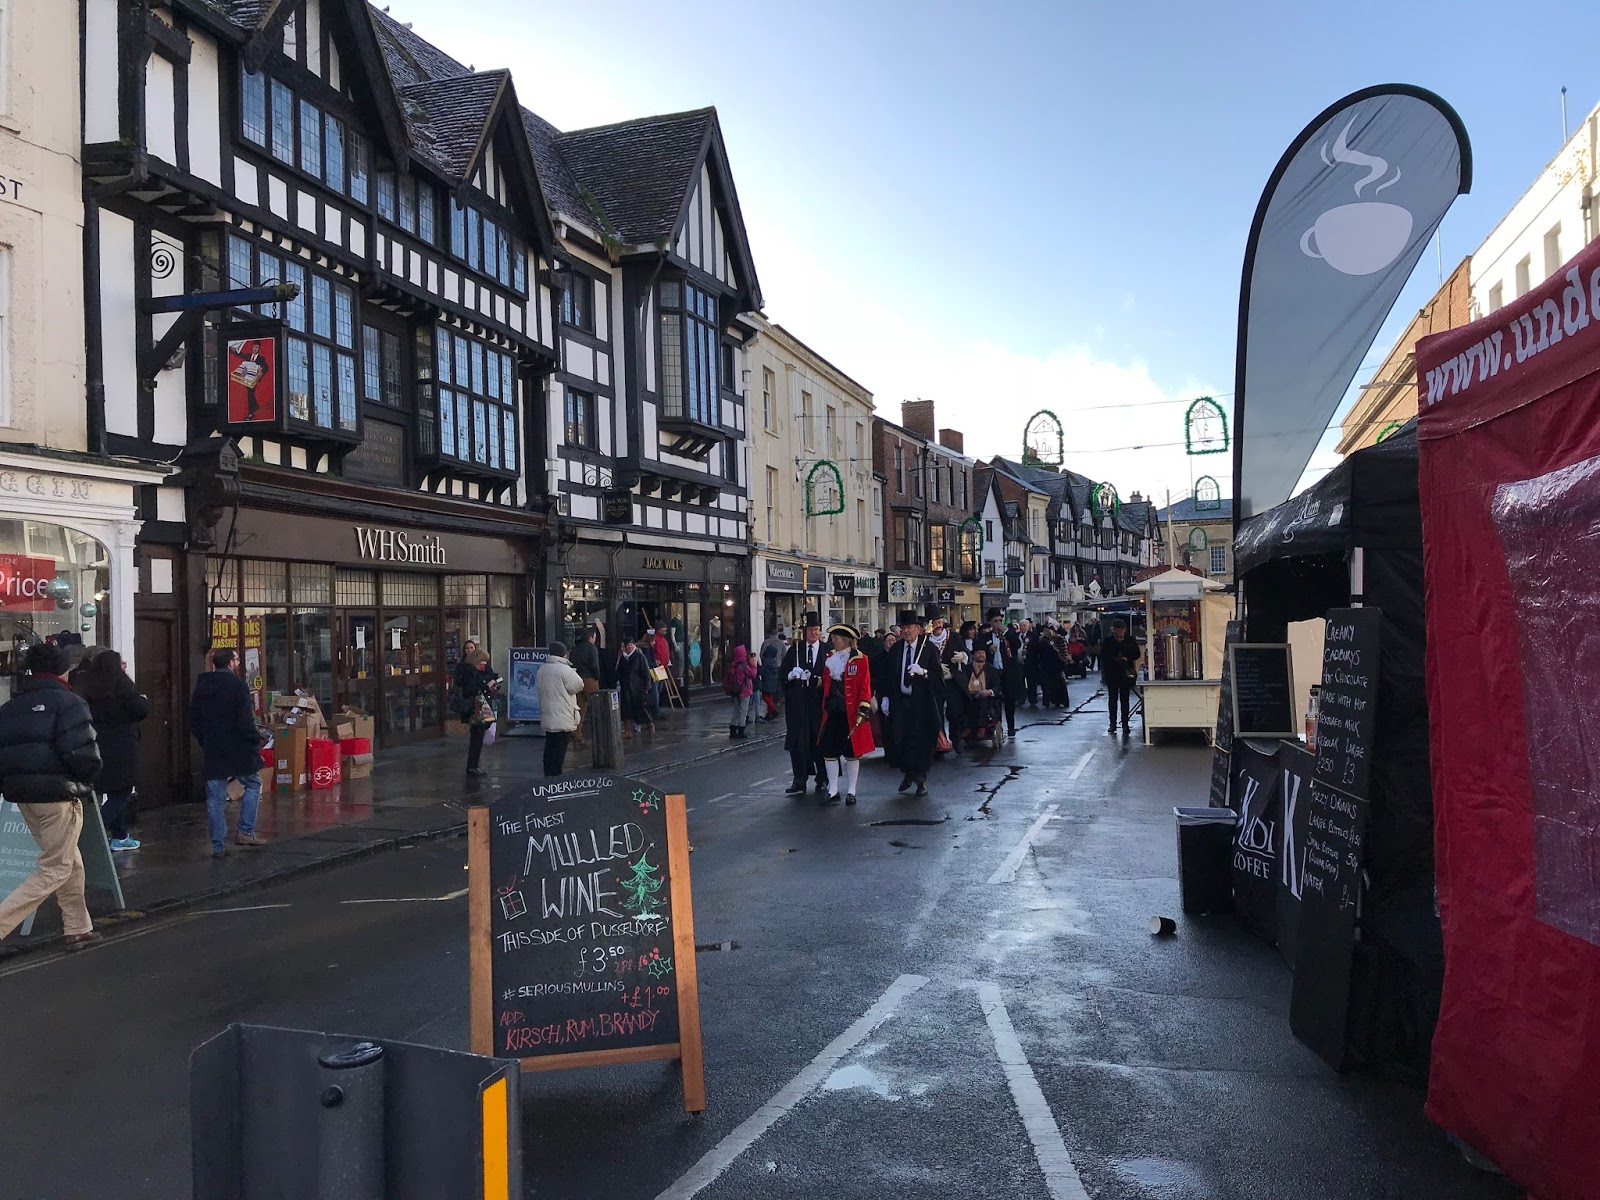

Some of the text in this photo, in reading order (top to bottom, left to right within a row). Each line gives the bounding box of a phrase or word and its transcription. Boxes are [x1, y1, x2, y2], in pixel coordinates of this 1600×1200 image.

[355, 526, 447, 565] WHSmith
[645, 557, 684, 571] JACK WILLS
[838, 579, 851, 590] W
[212, 620, 228, 638] Big
[211, 638, 237, 649] MASSIVE
[513, 651, 530, 660] Out
[532, 779, 596, 797] UNDERWOOD
[525, 811, 566, 832] FINEST
[523, 822, 645, 876] MULLED
[541, 867, 624, 919] WINE
[497, 930, 531, 953] THIS
[530, 929, 568, 946] SIDE
[567, 924, 586, 940] OF
[599, 1009, 660, 1037] BRANDY
